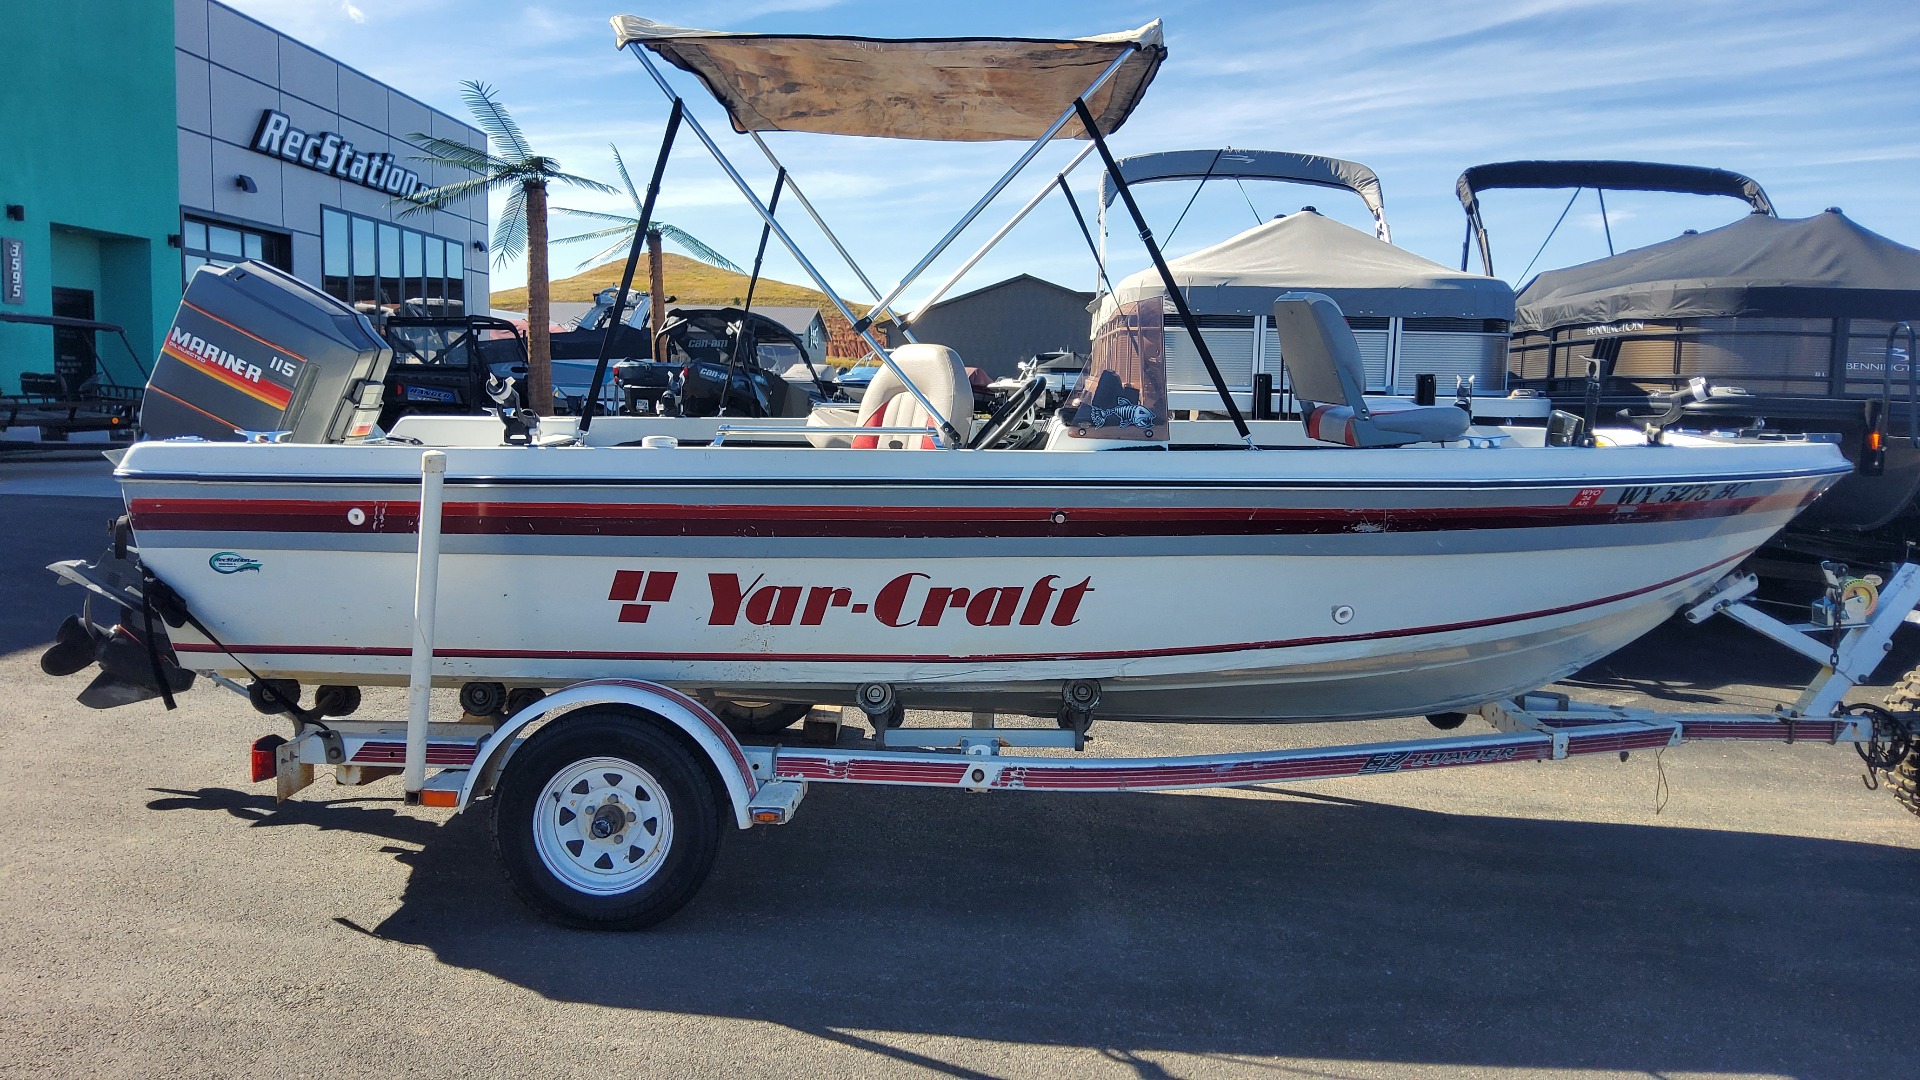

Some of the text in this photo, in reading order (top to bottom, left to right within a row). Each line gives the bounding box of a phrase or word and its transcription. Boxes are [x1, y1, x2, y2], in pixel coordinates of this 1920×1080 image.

[257, 111, 450, 203] RecStation
[10, 243, 21, 298] 3595
[168, 341, 206, 364] OIL INJECTED
[171, 326, 262, 384] MARINER
[688, 339, 729, 348] can-am
[269, 355, 297, 378] 115
[409, 388, 451, 400] RANGER
[1617, 486, 1660, 504] WY
[1660, 484, 1713, 503] 5275
[707, 572, 1095, 628] Yar-Craft
[1358, 747, 1519, 775] EZ LOADER
